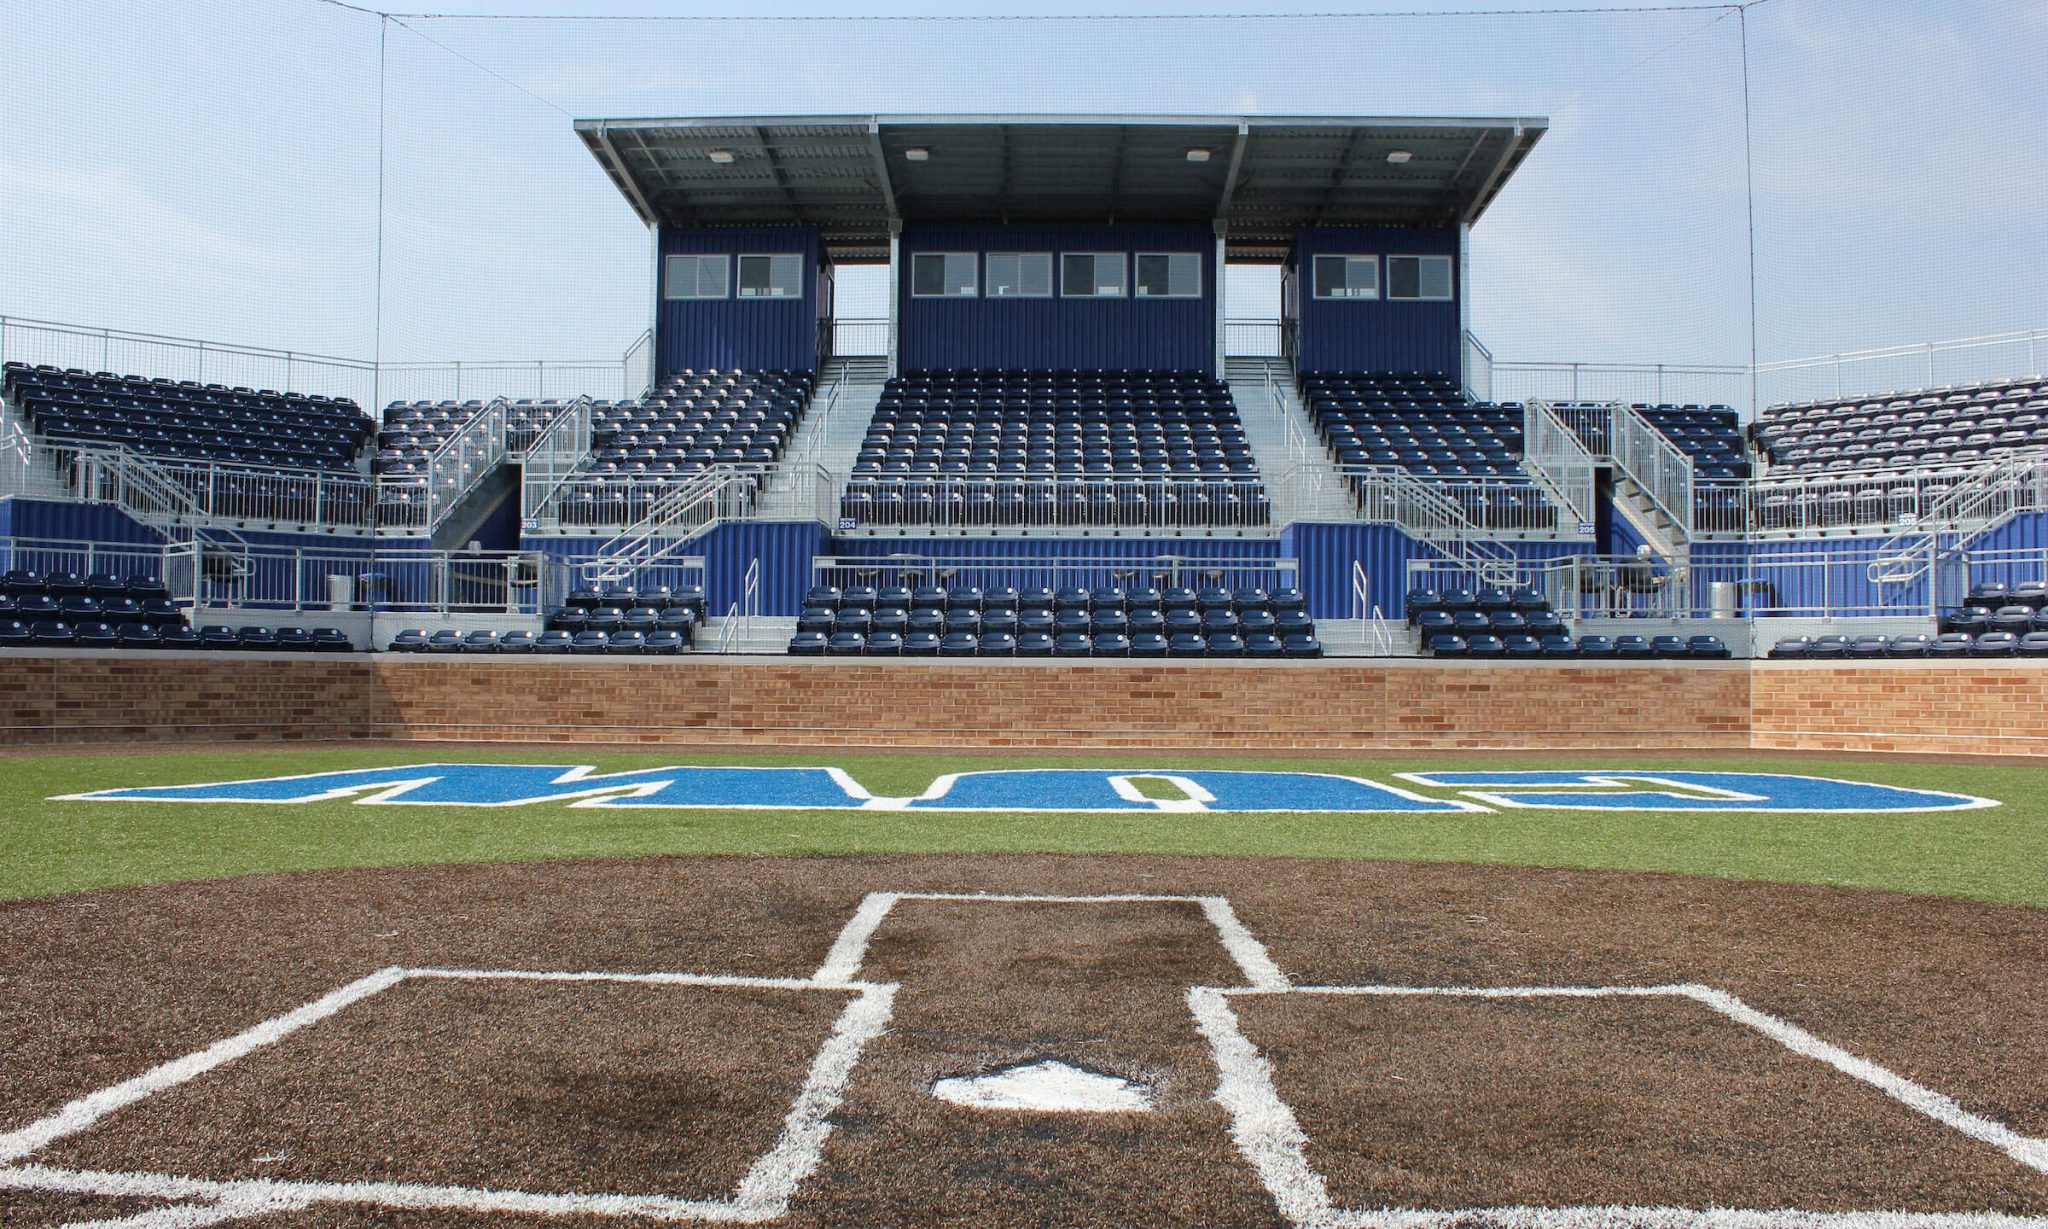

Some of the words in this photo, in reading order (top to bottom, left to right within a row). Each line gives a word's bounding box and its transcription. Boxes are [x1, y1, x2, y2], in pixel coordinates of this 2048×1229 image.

[521, 521, 537, 529] 203
[840, 521, 856, 529] 204
[1579, 526, 1595, 534] 205
